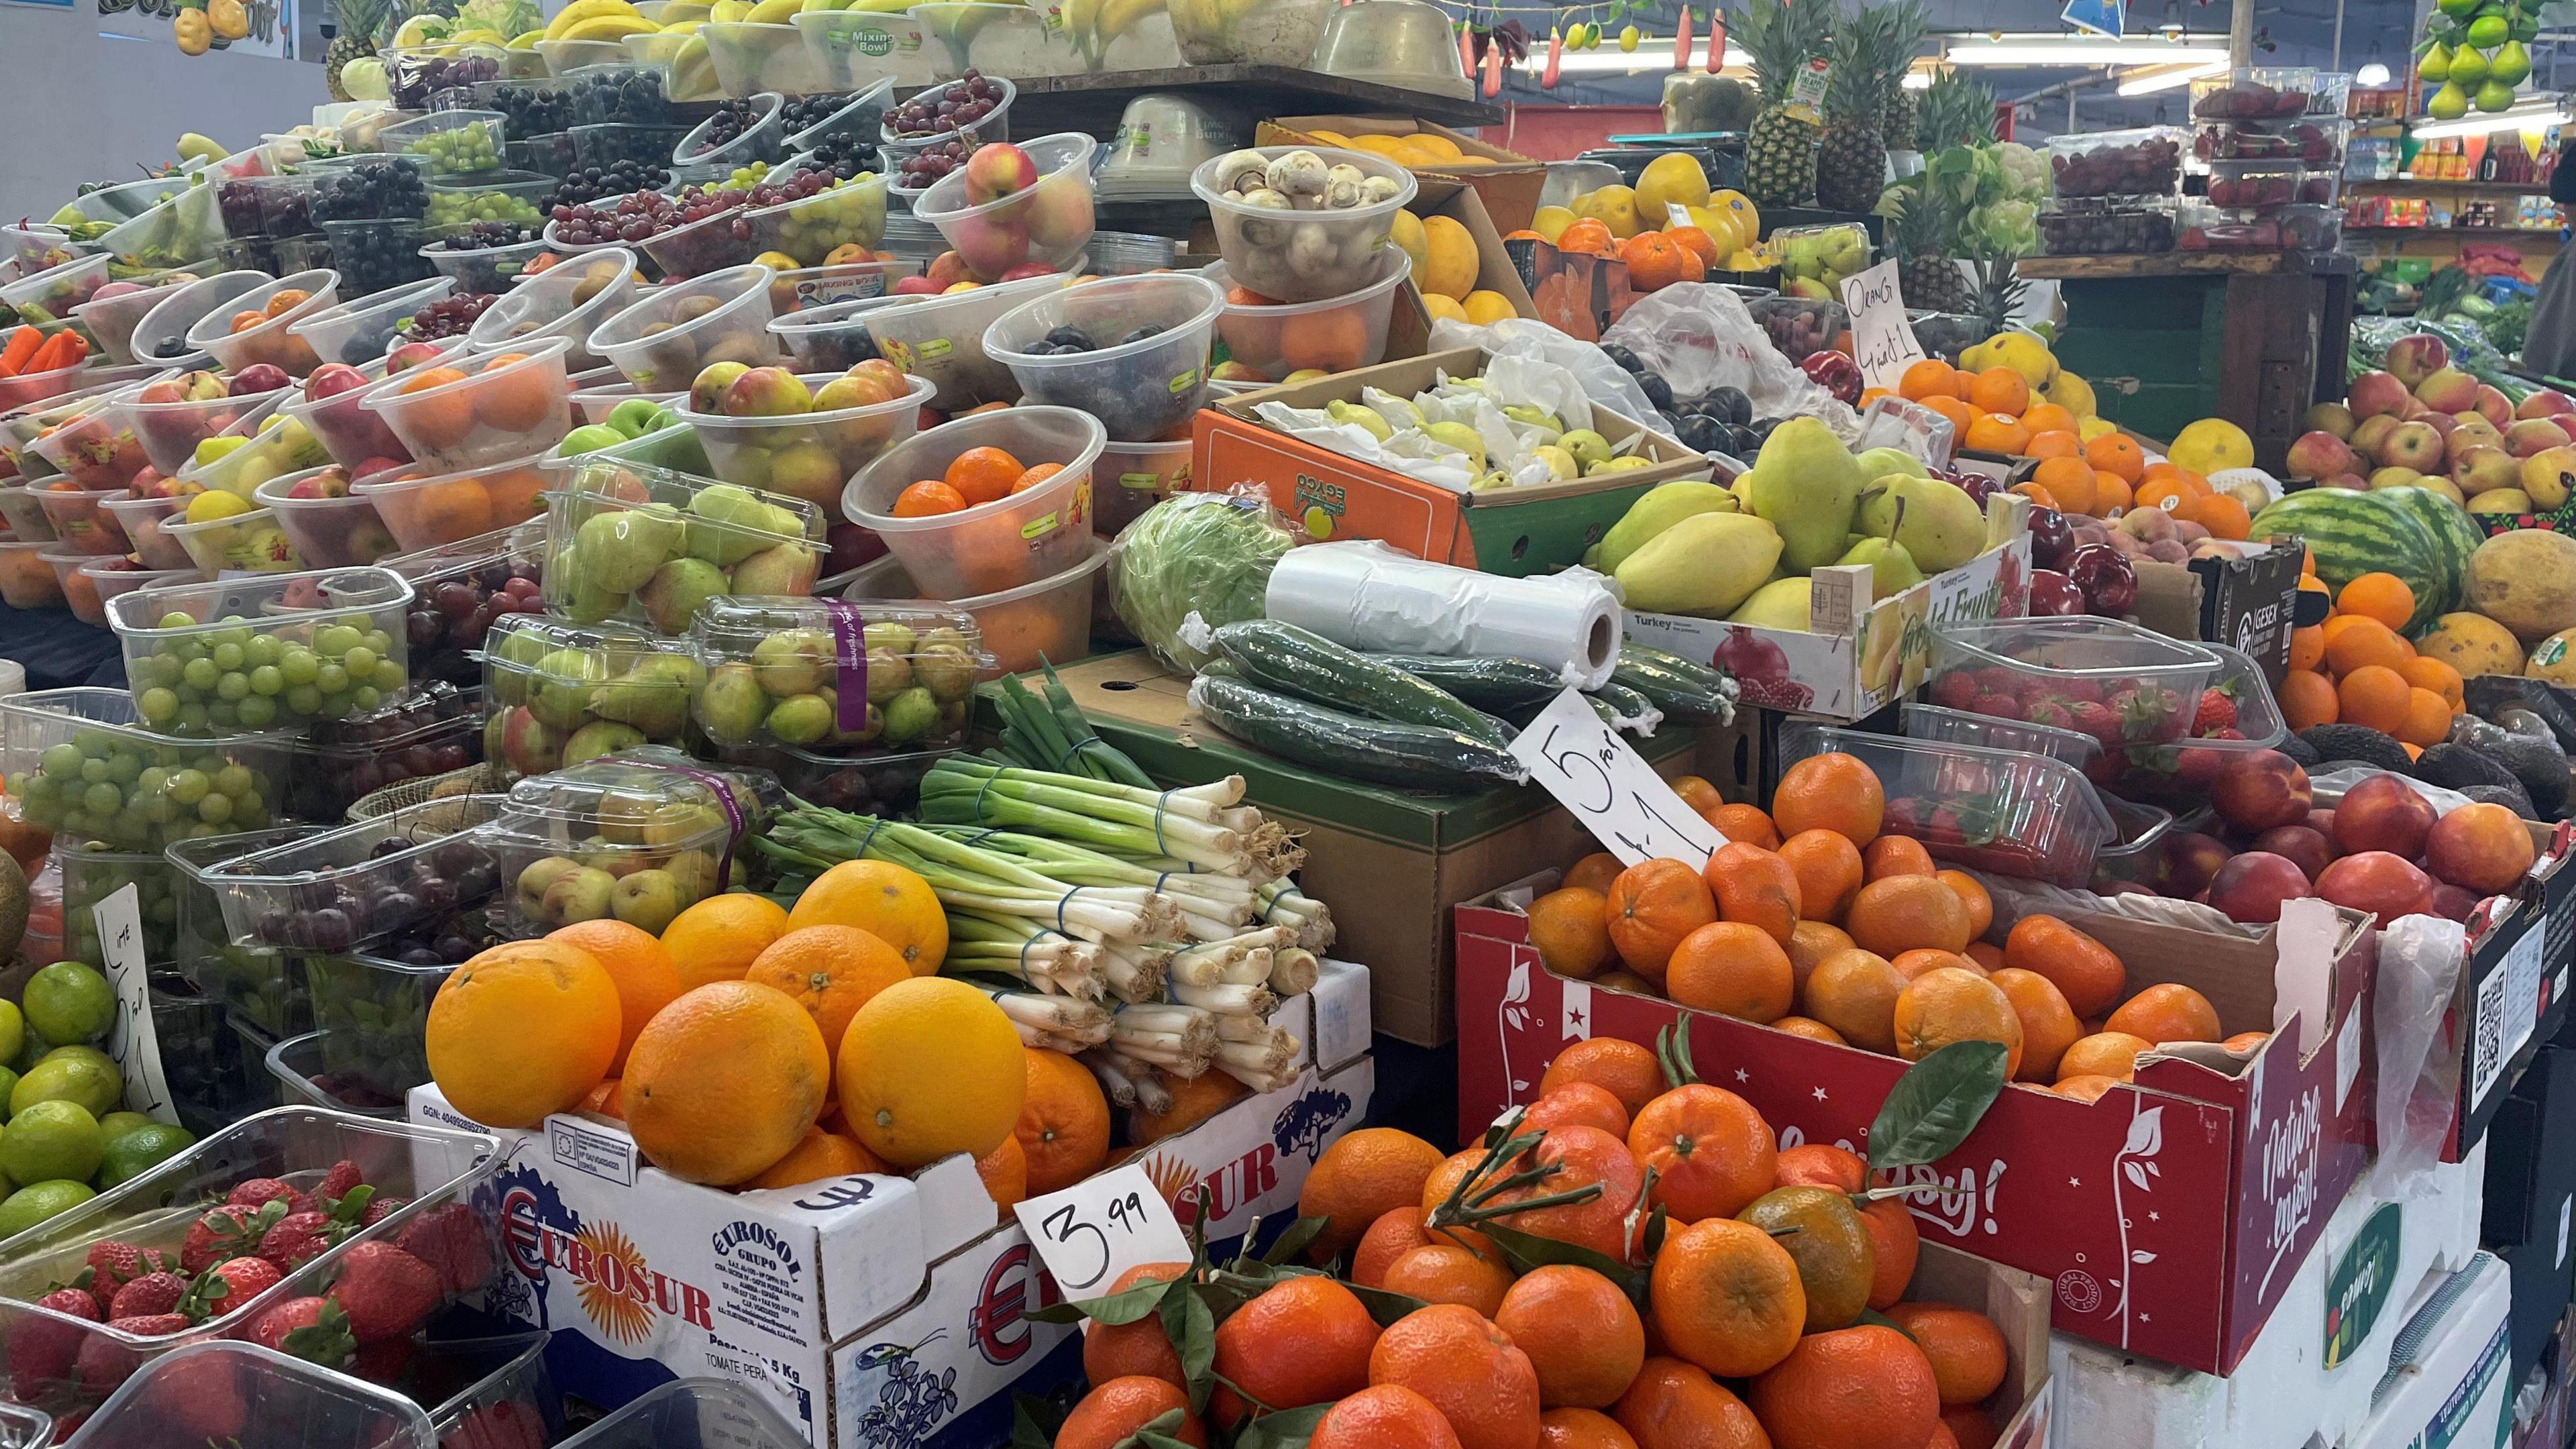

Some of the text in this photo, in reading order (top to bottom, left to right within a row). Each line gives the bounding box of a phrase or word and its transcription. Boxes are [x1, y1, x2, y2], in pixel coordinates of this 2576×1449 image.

[853, 32, 894, 43] Mixing
[860, 42, 887, 51] Bowl
[819, 280, 853, 289] MIXING
[1297, 473, 1346, 502] EGYCO
[1941, 576, 1957, 590] Turkey
[847, 623, 855, 632] of
[1635, 614, 1672, 630] Turkey
[2255, 602, 2279, 630] GESEX
[849, 633, 858, 670] freshness
[1541, 724, 1613, 813] 5
[423, 1105, 440, 1120] GGN:
[2263, 1085, 2320, 1205] Nature
[1042, 1192, 1147, 1289] 3.99
[738, 1249, 776, 1271] GRUPO
[2060, 1273, 2098, 1309] NATURAL PRODUCT
[705, 1353, 741, 1374] TOMATE
[743, 1363, 767, 1382] PERA
[771, 1359, 800, 1384] 5 Kg
